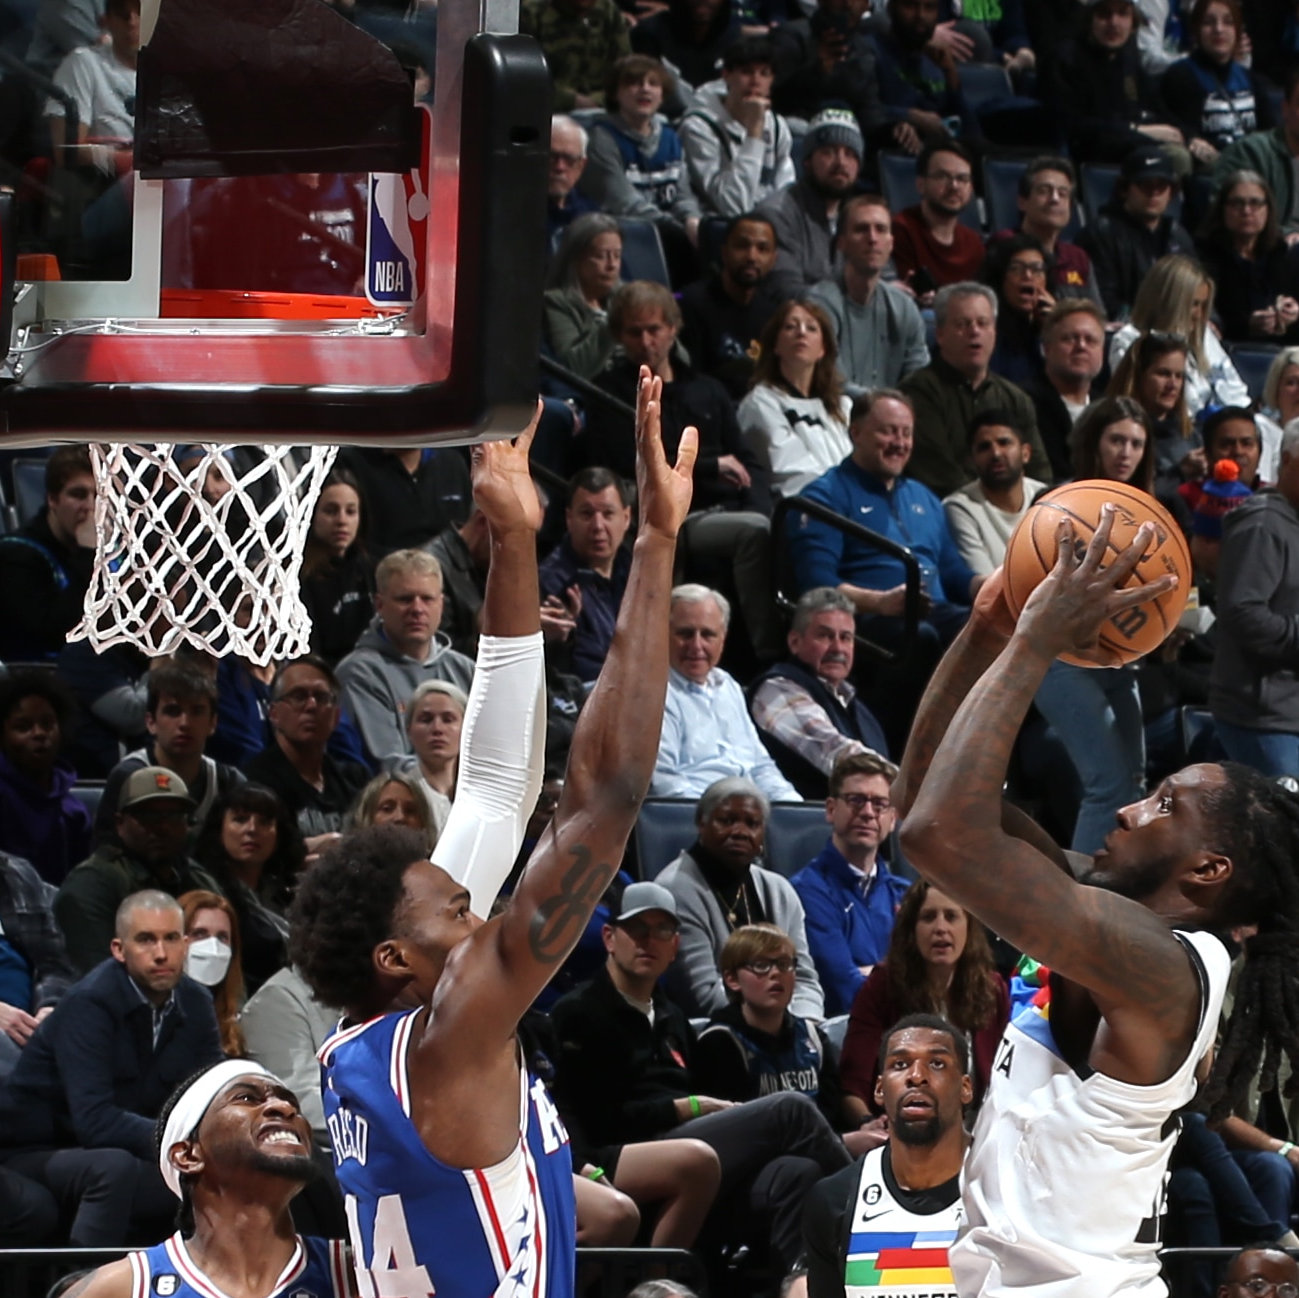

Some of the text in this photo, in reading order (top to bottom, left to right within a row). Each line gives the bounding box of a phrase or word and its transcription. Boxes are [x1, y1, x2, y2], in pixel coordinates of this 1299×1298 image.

[374, 261, 404, 292] NBA
[867, 1187, 880, 1205] 6
[156, 1275, 176, 1296] 6
